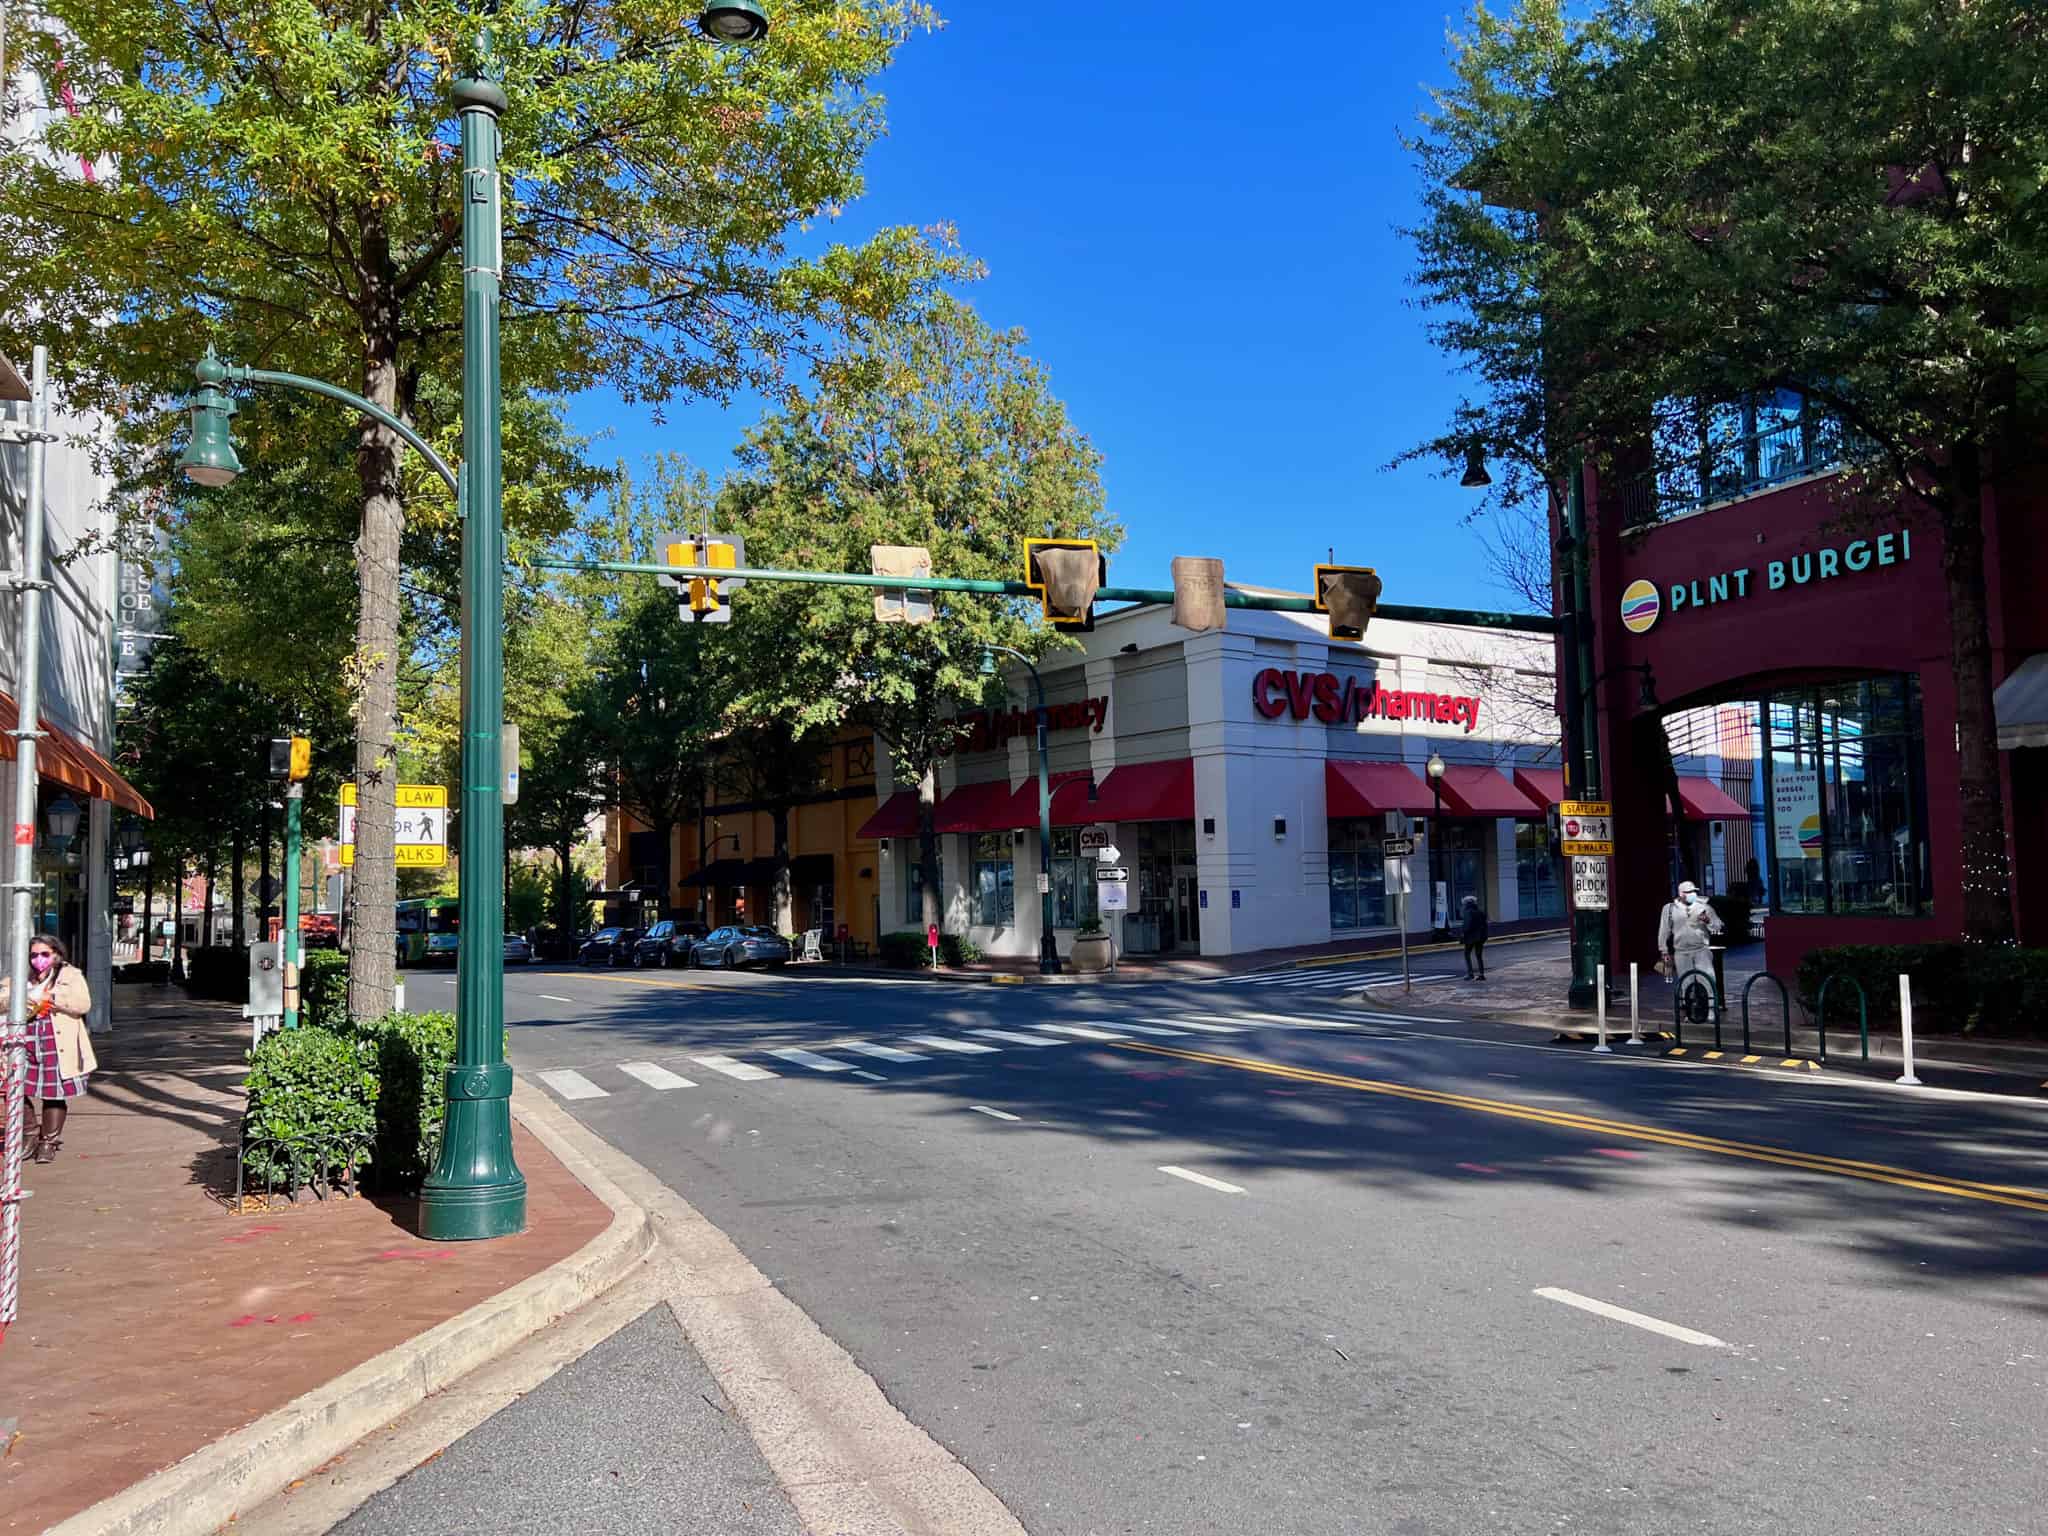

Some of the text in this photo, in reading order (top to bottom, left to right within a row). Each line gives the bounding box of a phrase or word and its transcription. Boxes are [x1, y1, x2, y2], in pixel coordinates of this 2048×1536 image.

[1671, 569, 1749, 611] PLNT
[1253, 667, 1481, 732] CVS/pharmacy
[404, 791, 433, 803] LAW
[1567, 804, 1607, 814] STATE LAW
[394, 821, 412, 833] OR
[1582, 825, 1597, 834] FOR
[1081, 831, 1105, 845] CVS
[1576, 862, 1605, 874] DO NOT
[1576, 879, 1606, 891] BLOCK
